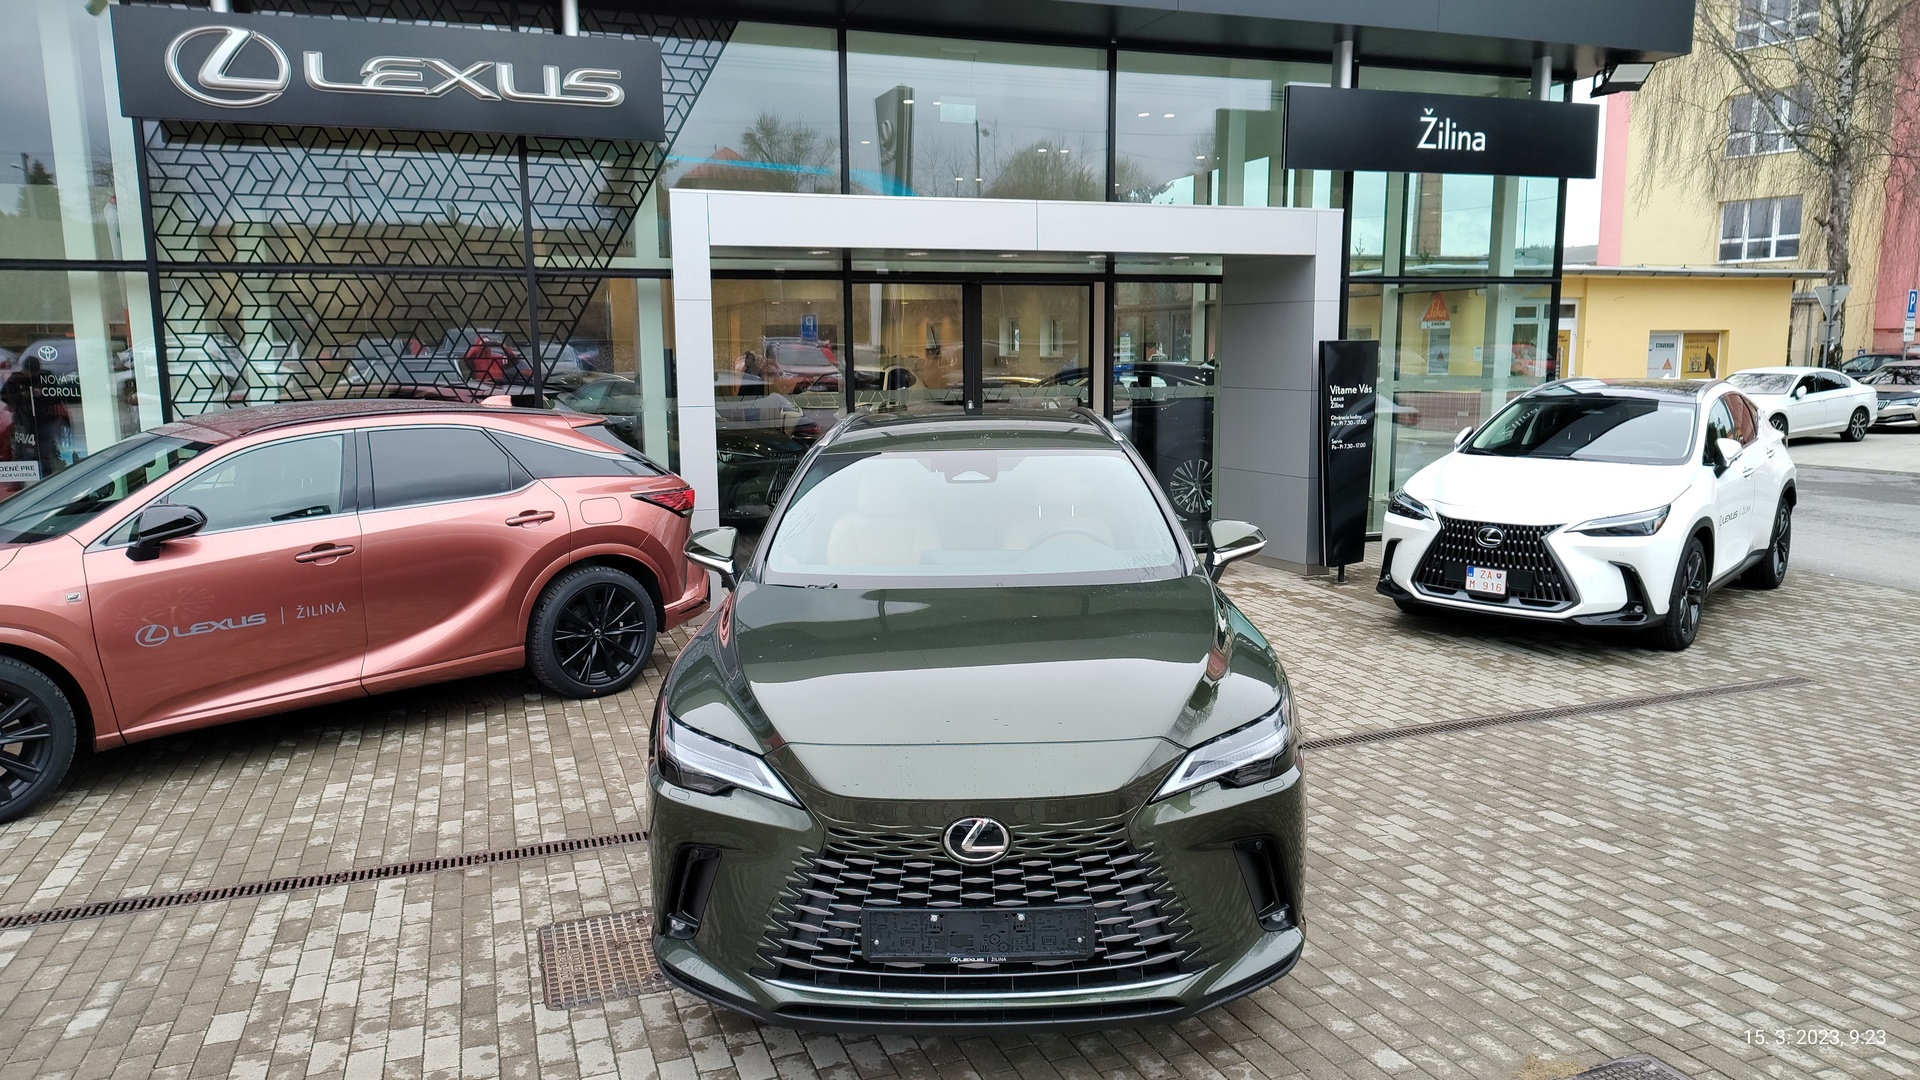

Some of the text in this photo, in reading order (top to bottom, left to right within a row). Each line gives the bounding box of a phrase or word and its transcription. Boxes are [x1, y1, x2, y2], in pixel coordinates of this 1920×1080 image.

[303, 50, 625, 107] LEXUS
[1417, 107, 1486, 151] Žilina
[40, 373, 68, 385] NOVÁ
[1329, 383, 1373, 394] Vítame Vás
[1330, 401, 1344, 409] Žilina
[1480, 569, 1492, 580] ZA
[1469, 579, 1502, 592] M 916
[172, 601, 346, 638] LEXUS ŽILINA
